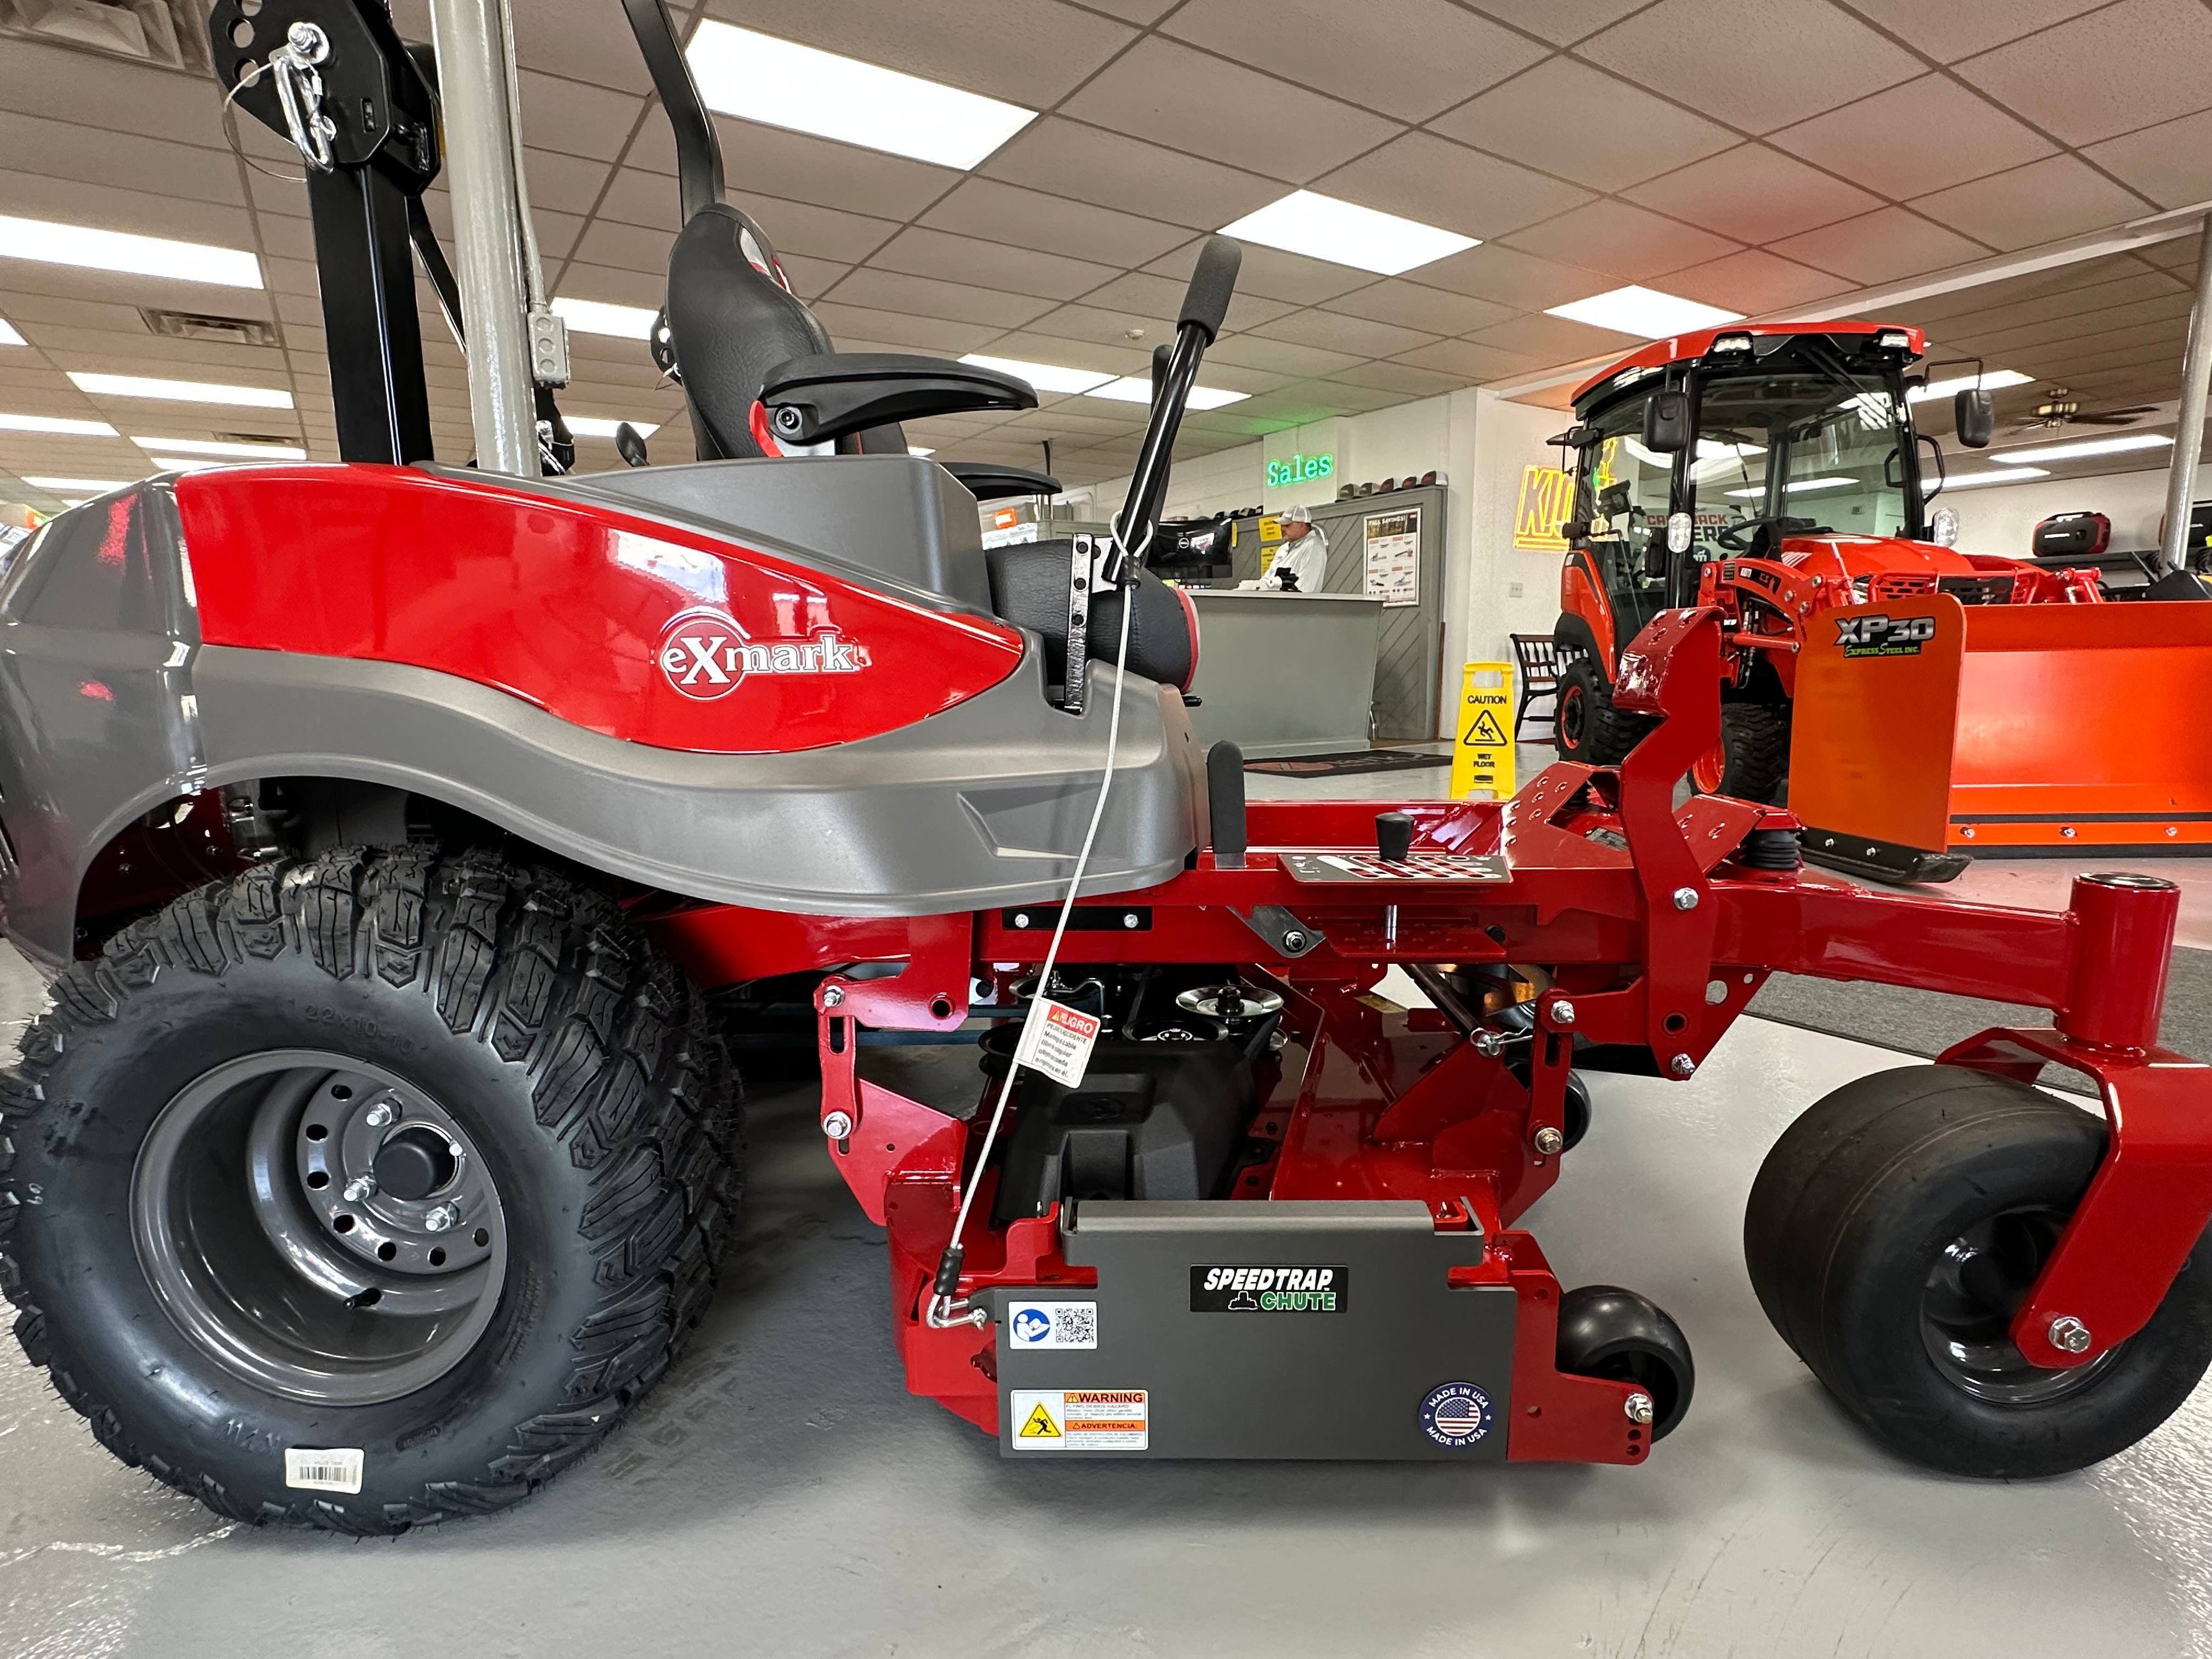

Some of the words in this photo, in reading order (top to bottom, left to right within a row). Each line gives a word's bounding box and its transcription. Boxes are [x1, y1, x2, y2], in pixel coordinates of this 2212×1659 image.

[1267, 454, 1331, 487] Sales
[1836, 616, 1935, 644] XP30
[1844, 645, 1878, 657] EXPRESS
[1878, 642, 1904, 655] STEEL
[1468, 695, 1506, 704] CAUTION
[1204, 1268, 1333, 1290] SPEEDTRAP
[1260, 1291, 1336, 1311] CHUTE
[1079, 1393, 1143, 1402] WARNING
[1429, 1388, 1457, 1407] MADE
[1459, 1387, 1471, 1396] IN
[1472, 1391, 1489, 1408] USA
[1426, 1426, 1453, 1445] MADE
[1467, 1429, 1487, 1443] USA
